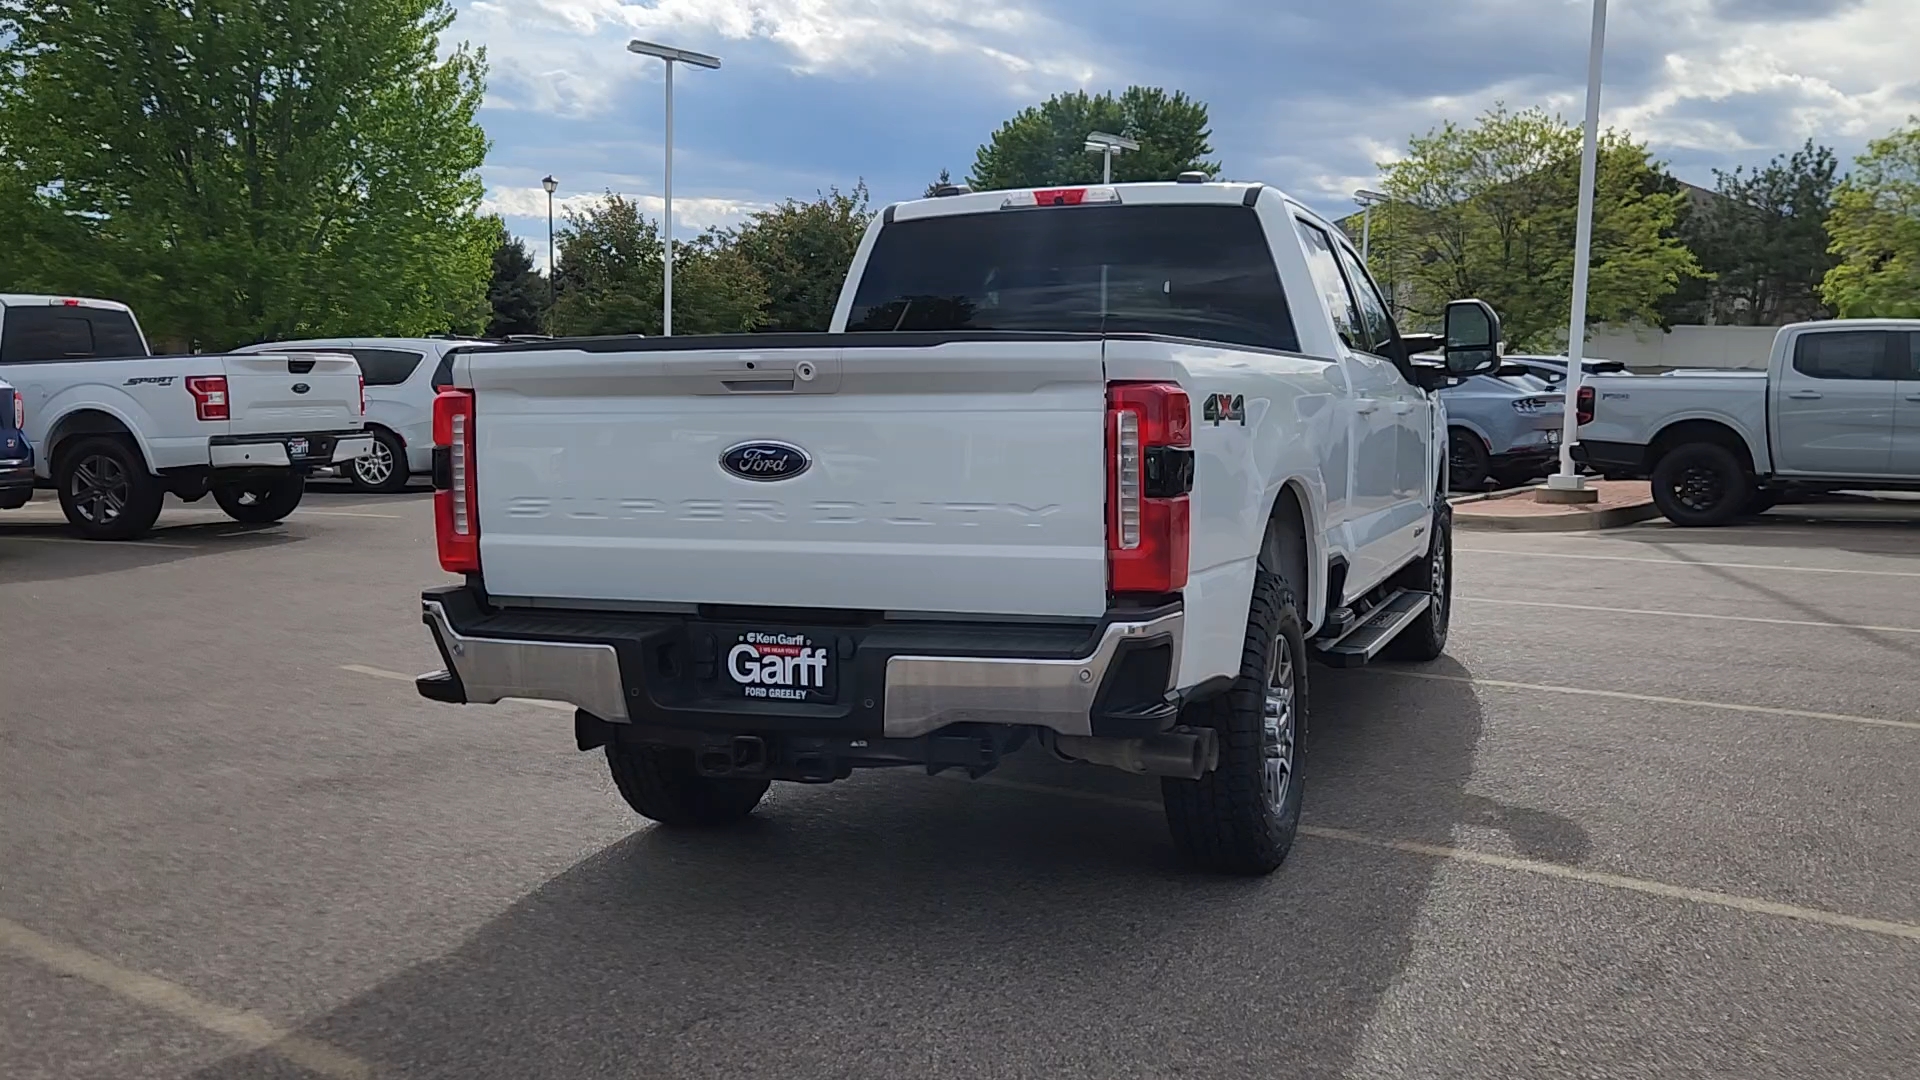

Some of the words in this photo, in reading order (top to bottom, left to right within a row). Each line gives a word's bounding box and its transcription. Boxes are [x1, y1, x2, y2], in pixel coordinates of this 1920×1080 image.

[122, 375, 179, 386] SPORT
[739, 448, 789, 472] Ford
[504, 496, 789, 523] SUPER
[807, 500, 1061, 527] DUTY
[756, 633, 777, 644] Ken
[777, 634, 805, 646] Garff
[727, 643, 827, 687] Garff
[745, 686, 767, 697] FORD
[768, 688, 807, 700] GREELEY
